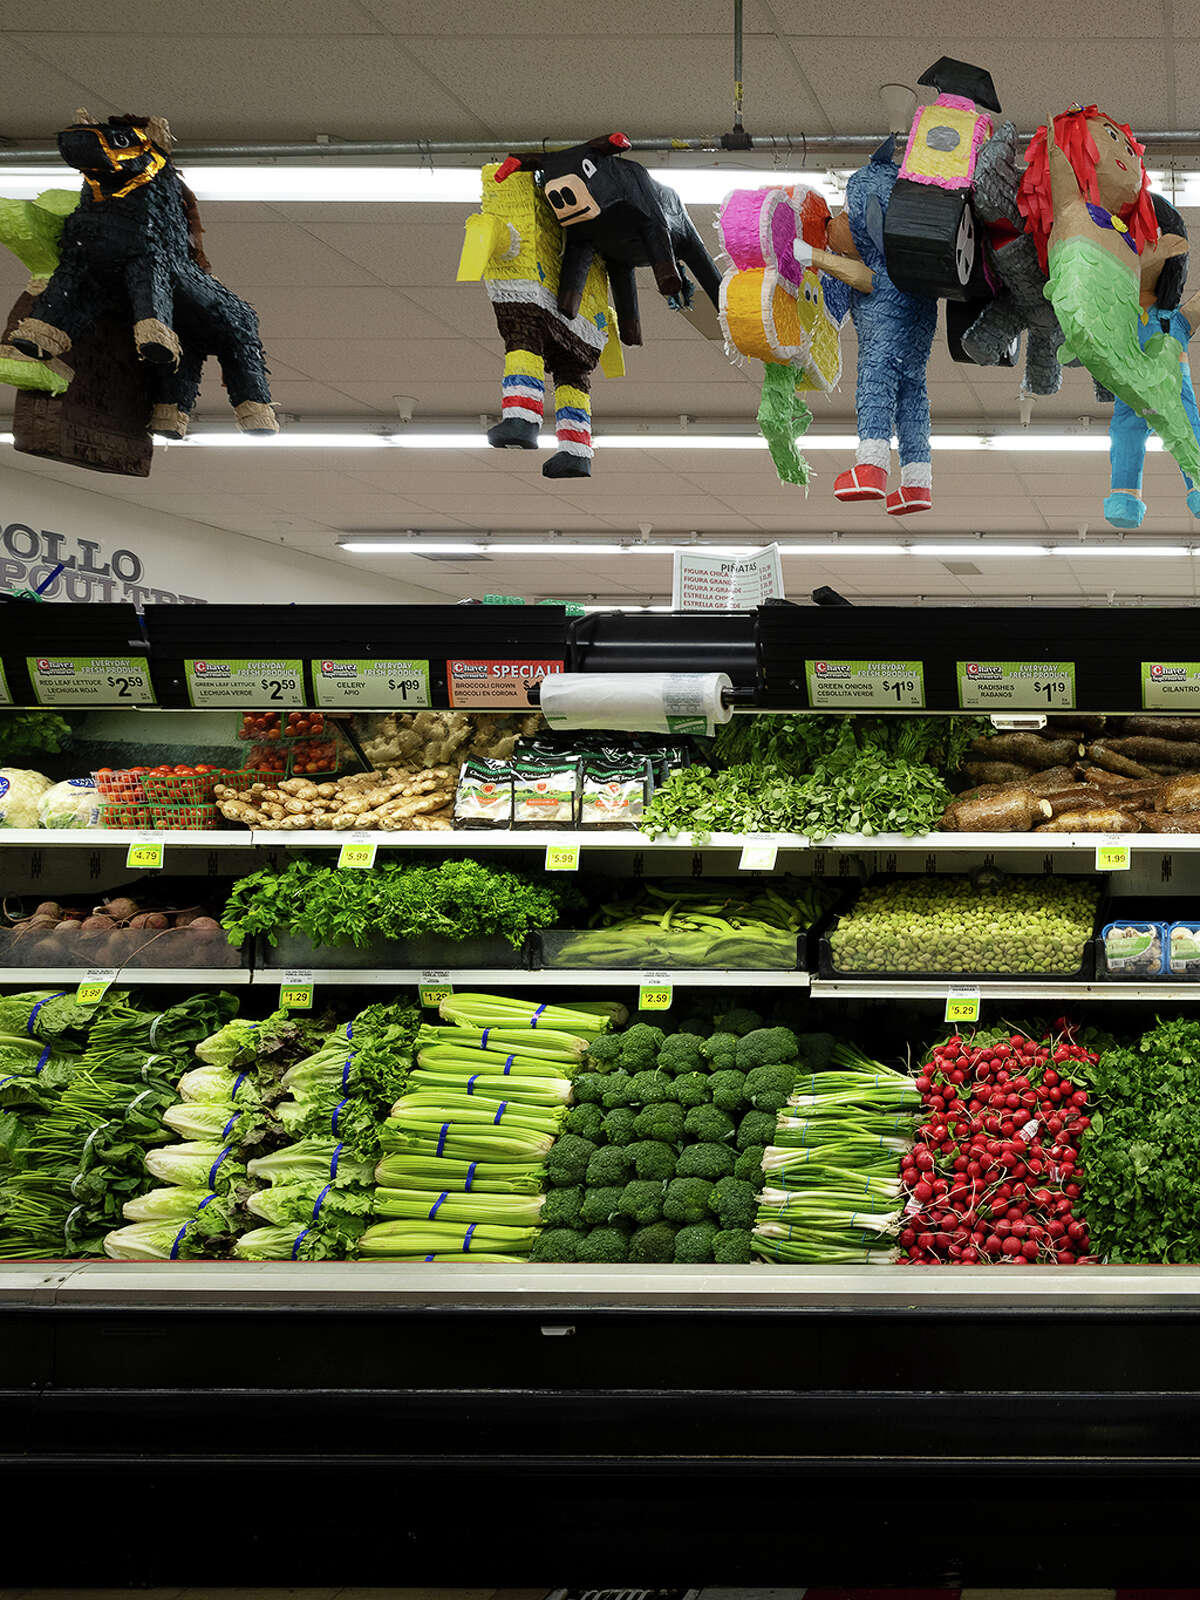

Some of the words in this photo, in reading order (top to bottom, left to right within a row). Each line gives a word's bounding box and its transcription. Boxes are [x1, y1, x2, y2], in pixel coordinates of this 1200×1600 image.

[0, 522, 142, 583] OLLO
[684, 568, 708, 576] FIGURA
[684, 576, 708, 584] FIGURA
[684, 584, 708, 592] FIGURA
[683, 592, 713, 600] ESTRELLA
[683, 600, 713, 608] ESTRELLA
